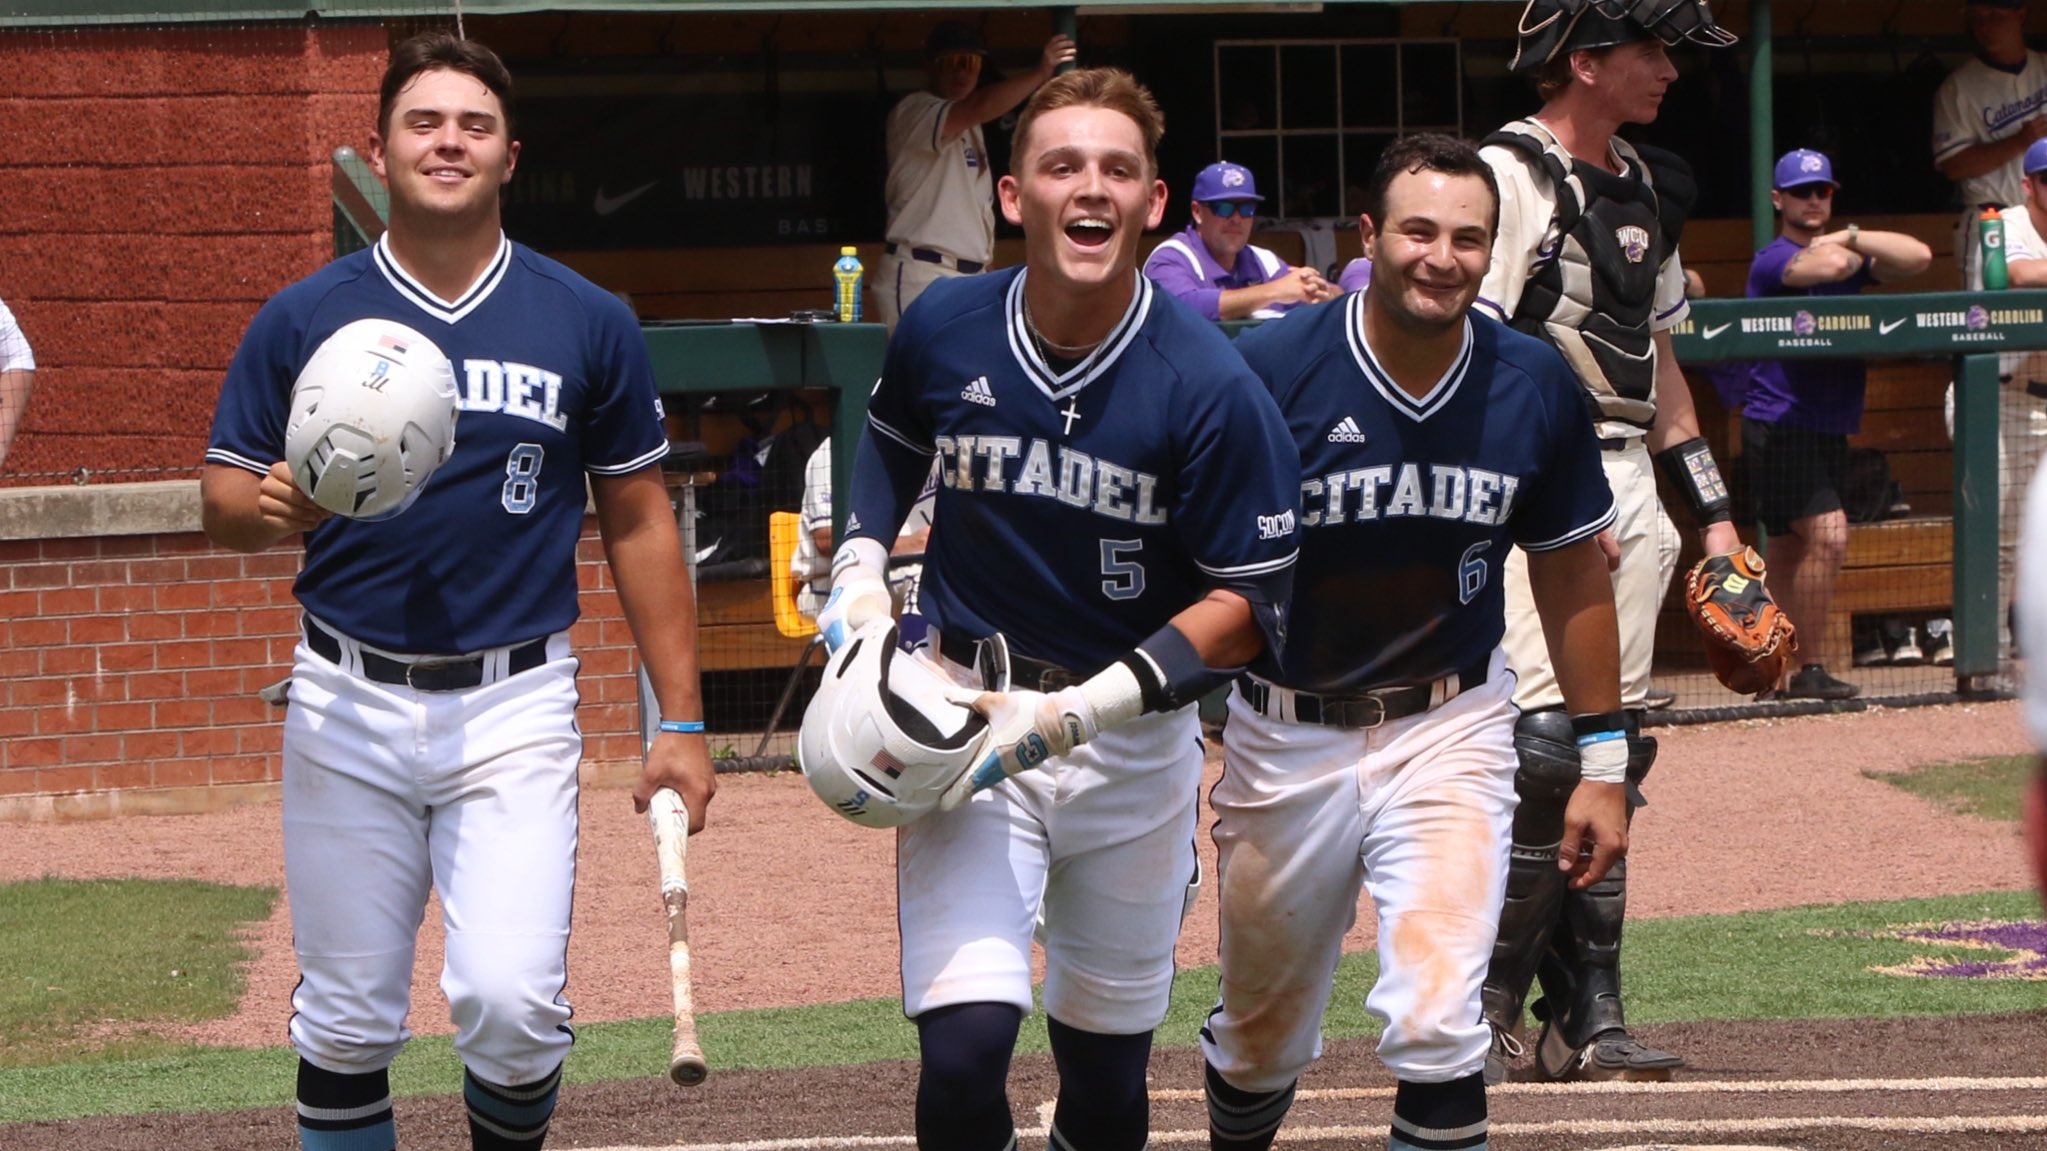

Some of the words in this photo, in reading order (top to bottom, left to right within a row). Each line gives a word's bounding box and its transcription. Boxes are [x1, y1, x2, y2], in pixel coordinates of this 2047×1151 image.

[683, 165, 812, 200] WESTERN
[1616, 226, 1649, 249] WCU
[1984, 230, 2000, 248] G
[1741, 317, 1792, 333] WESTERN
[1817, 315, 1871, 331] CAROLINA
[1916, 312, 1966, 328] WESTERN
[1990, 309, 2044, 325] CAROLINA
[1777, 338, 1832, 347] BASEBALL
[1951, 332, 2005, 342] BASEBALL
[961, 391, 996, 407] adidas
[1328, 432, 1365, 443] adidas
[501, 442, 545, 514] 8
[935, 435, 1167, 525] CITADEL
[1300, 462, 1520, 527] CITADEL
[1257, 508, 1295, 540] SOCON
[1100, 538, 1146, 600] 5
[1458, 539, 1492, 605] 6
